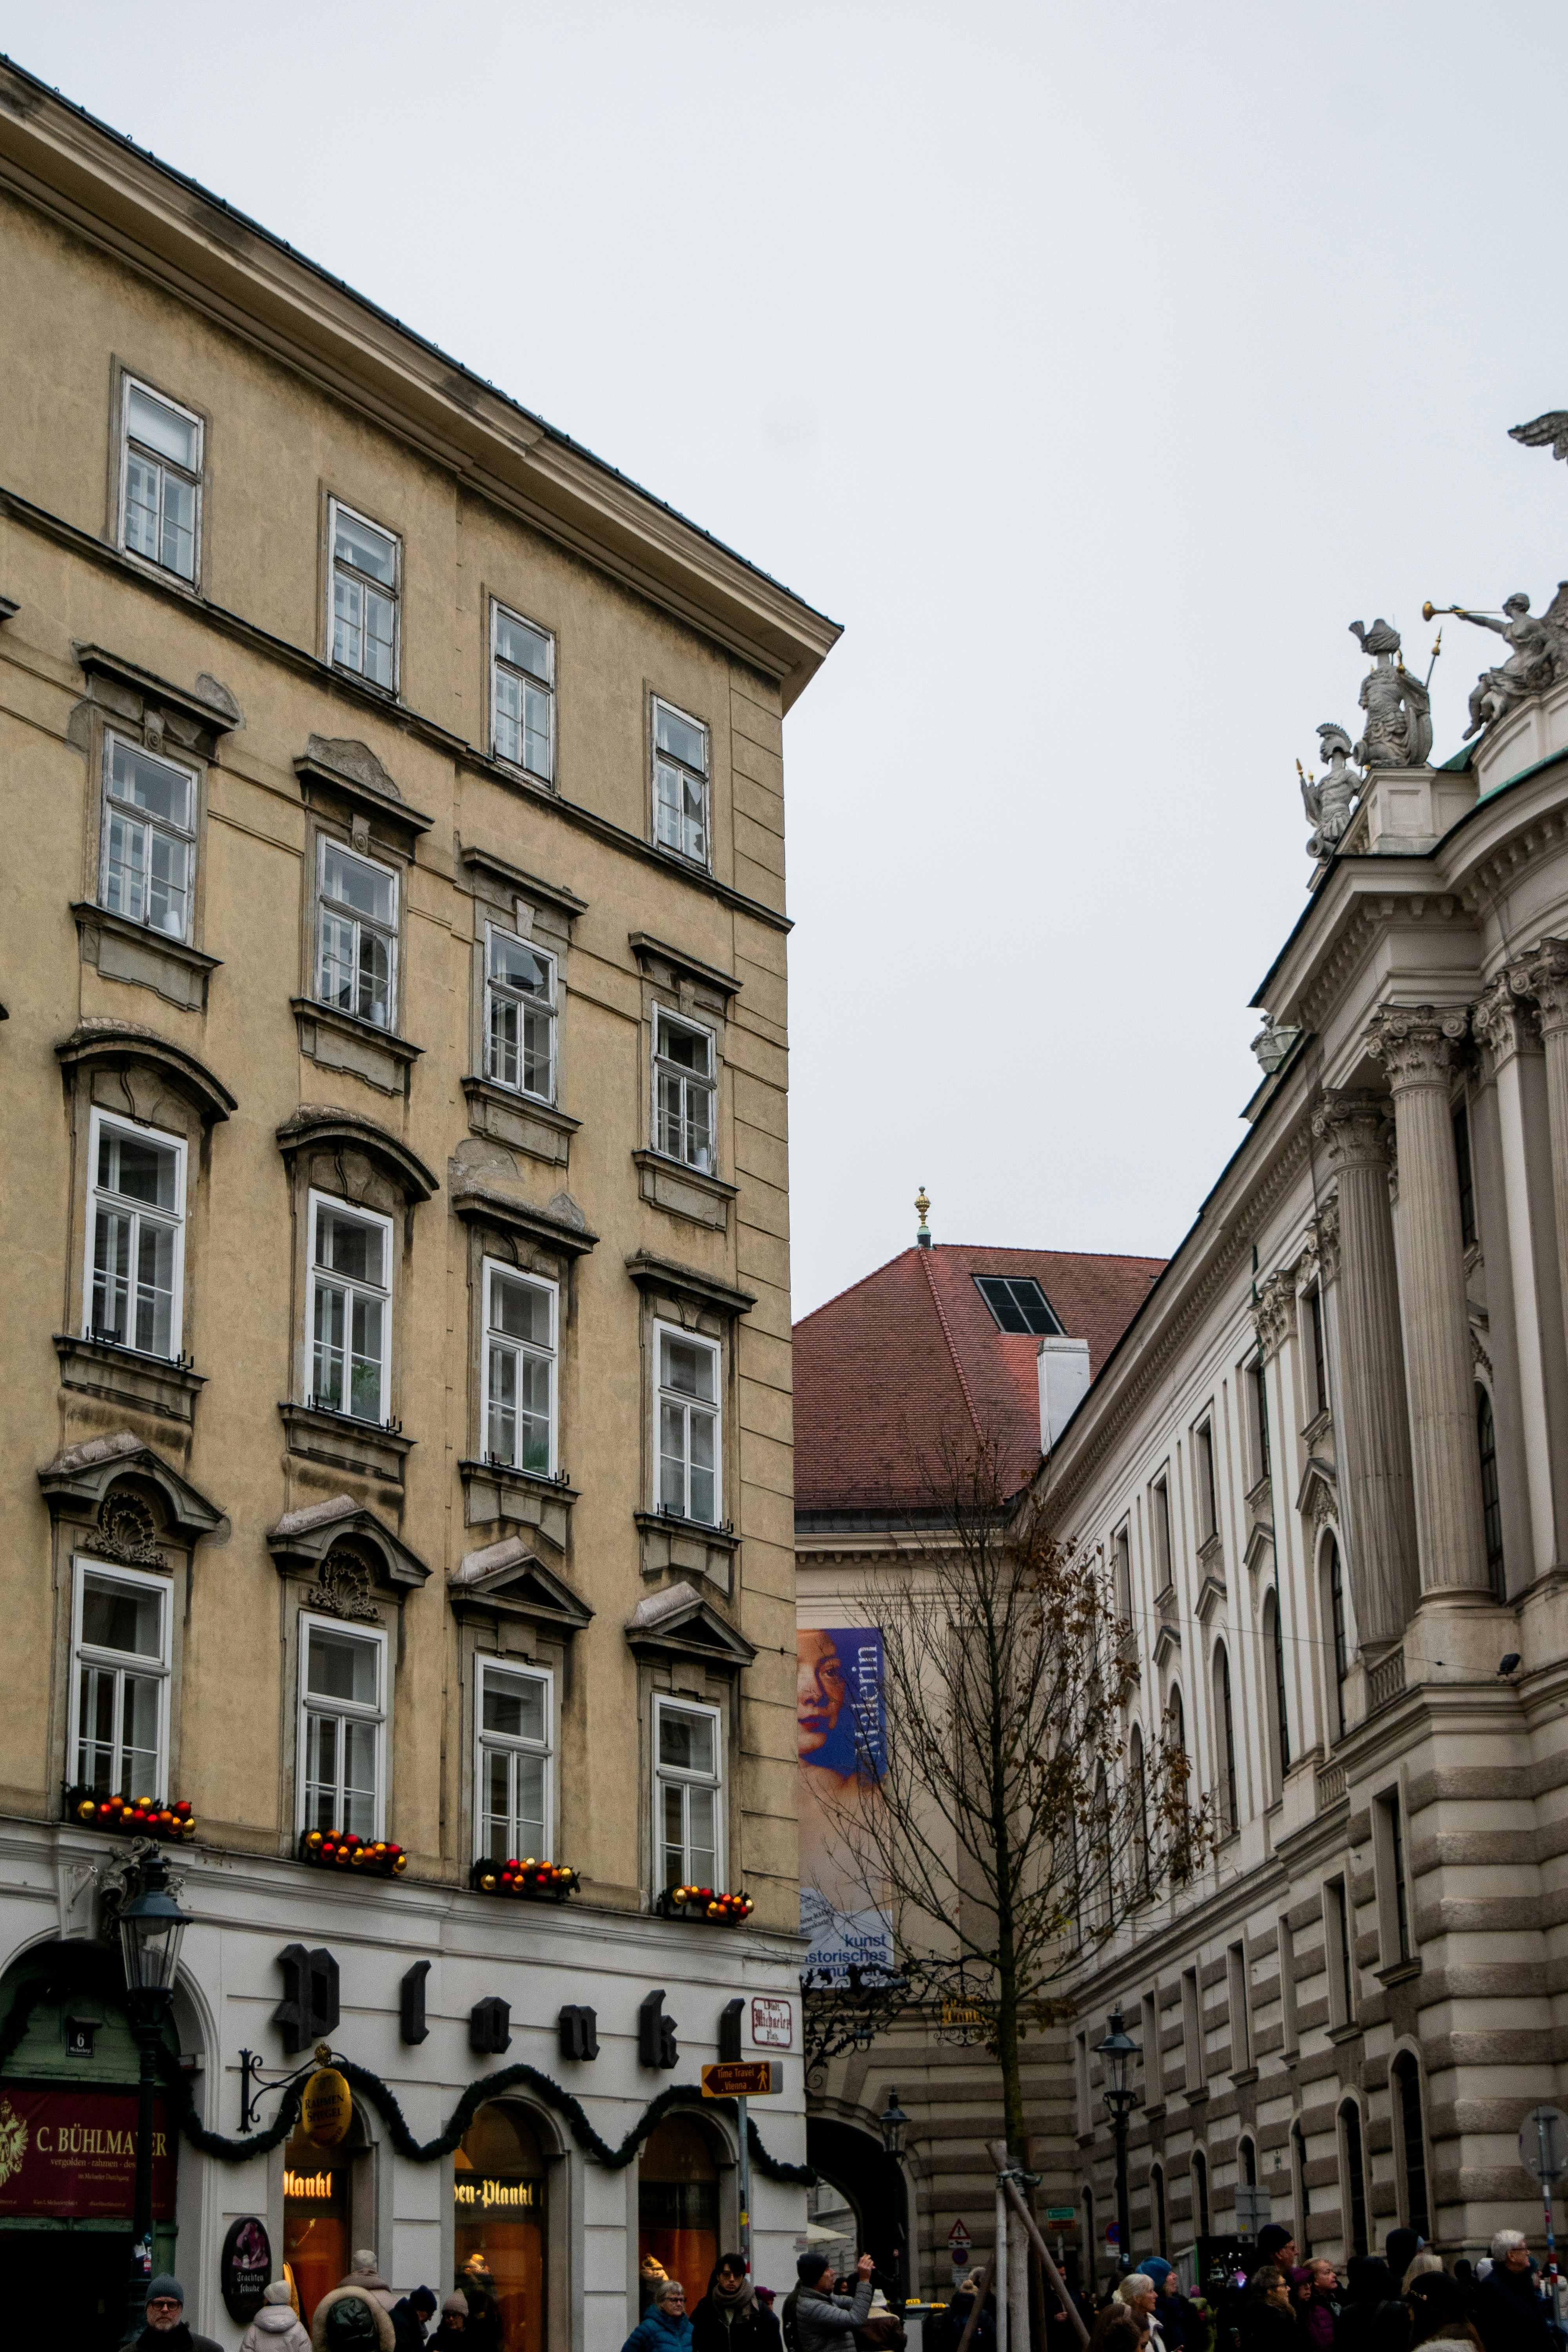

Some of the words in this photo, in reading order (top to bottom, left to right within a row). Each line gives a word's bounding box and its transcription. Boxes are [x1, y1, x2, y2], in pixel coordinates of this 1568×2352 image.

[851, 1644, 880, 1756] Malerin
[845, 1934, 886, 1947] kunst
[77, 2032, 85, 2047] 6
[717, 2068, 733, 2079] Time
[734, 2067, 755, 2077] Travel
[724, 2081, 747, 2091] Vienna
[305, 2093, 344, 2110] RAHMEN
[307, 2107, 343, 2122] SPIEGEL
[36, 2126, 53, 2152] C.
[58, 2123, 167, 2157] BÜHLMAER
[51, 2157, 85, 2168] vergolden
[91, 2158, 118, 2168] rahmen
